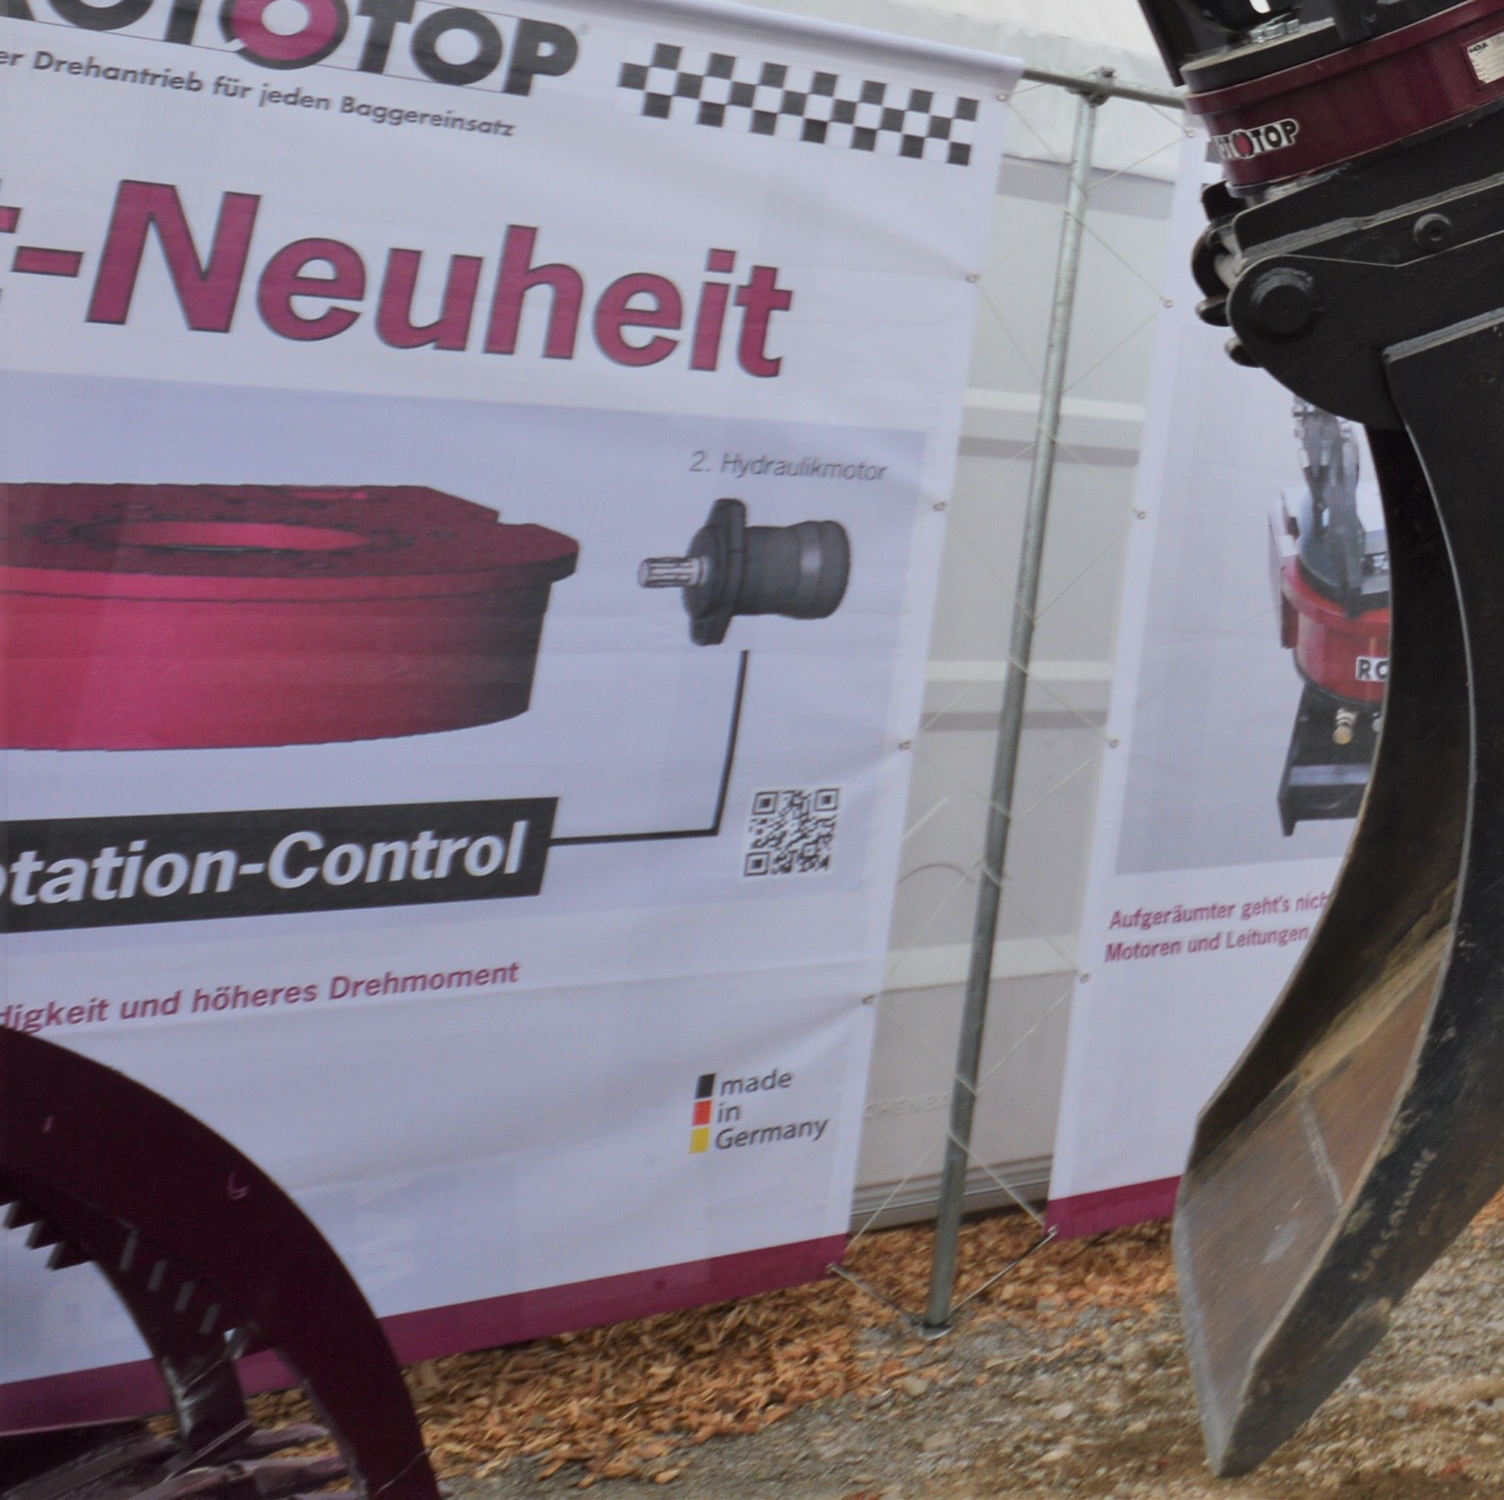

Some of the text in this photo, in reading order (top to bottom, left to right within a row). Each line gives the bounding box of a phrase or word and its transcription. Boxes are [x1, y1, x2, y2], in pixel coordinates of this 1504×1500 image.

[32, 50, 204, 93] Drehantrieb
[212, 75, 253, 100] für
[258, 81, 332, 112] jeden
[338, 95, 517, 138] Baggereinsatz
[0, 179, 793, 378] -Neuheit
[689, 450, 889, 481] 2. Hydraulikmotor
[0, 819, 529, 906] tation-Control
[1108, 902, 1236, 931] Aufgeräumter
[1240, 894, 1291, 920] geht's
[1104, 925, 1310, 963] Motoren und Leitungen
[119, 990, 182, 1020] und
[192, 980, 318, 1014] höheres
[330, 961, 521, 1001] Drehmoment
[718, 1068, 794, 1097] made
[716, 1103, 741, 1125] in
[715, 1118, 830, 1151] Germany
